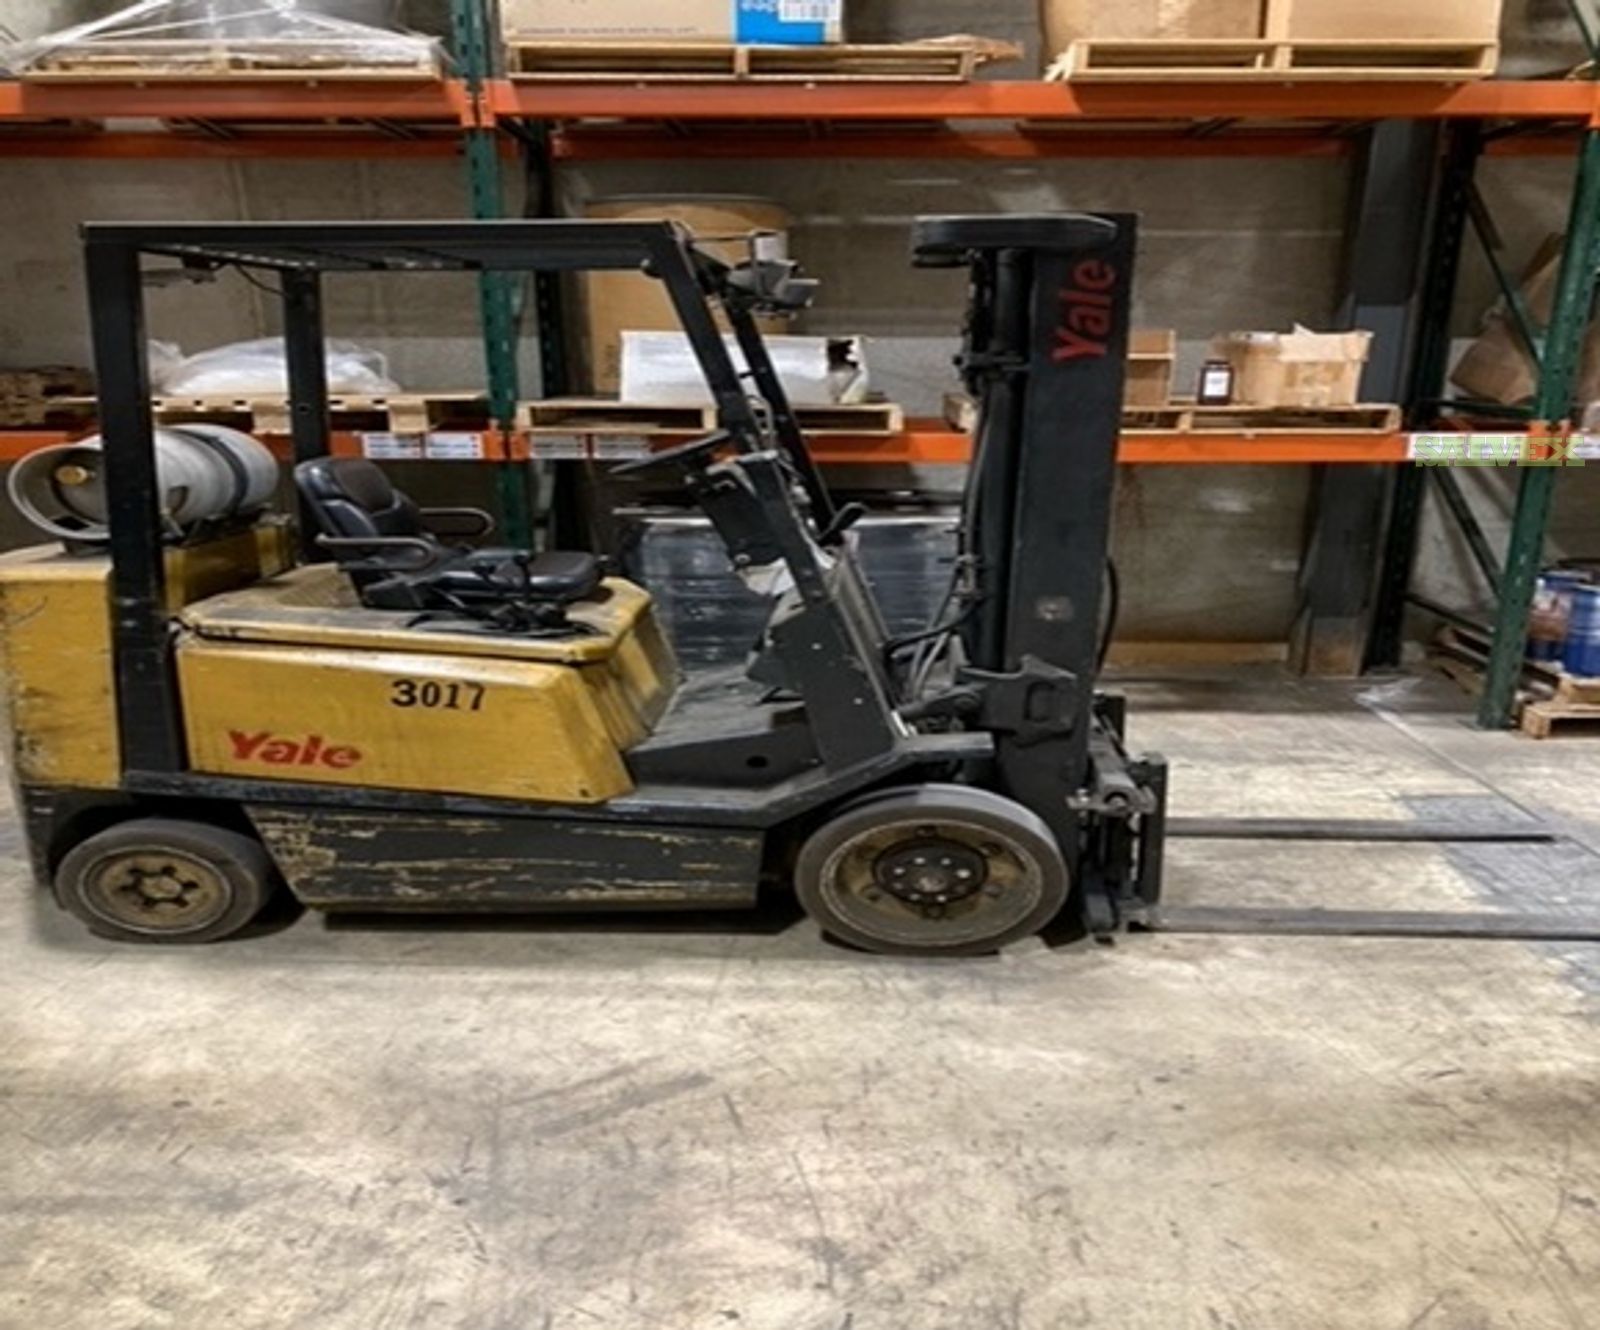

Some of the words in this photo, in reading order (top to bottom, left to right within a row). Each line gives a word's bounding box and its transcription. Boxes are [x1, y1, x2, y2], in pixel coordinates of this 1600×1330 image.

[1052, 260, 1116, 359] Yale
[390, 678, 486, 711] 3017
[228, 729, 363, 768] Yale
